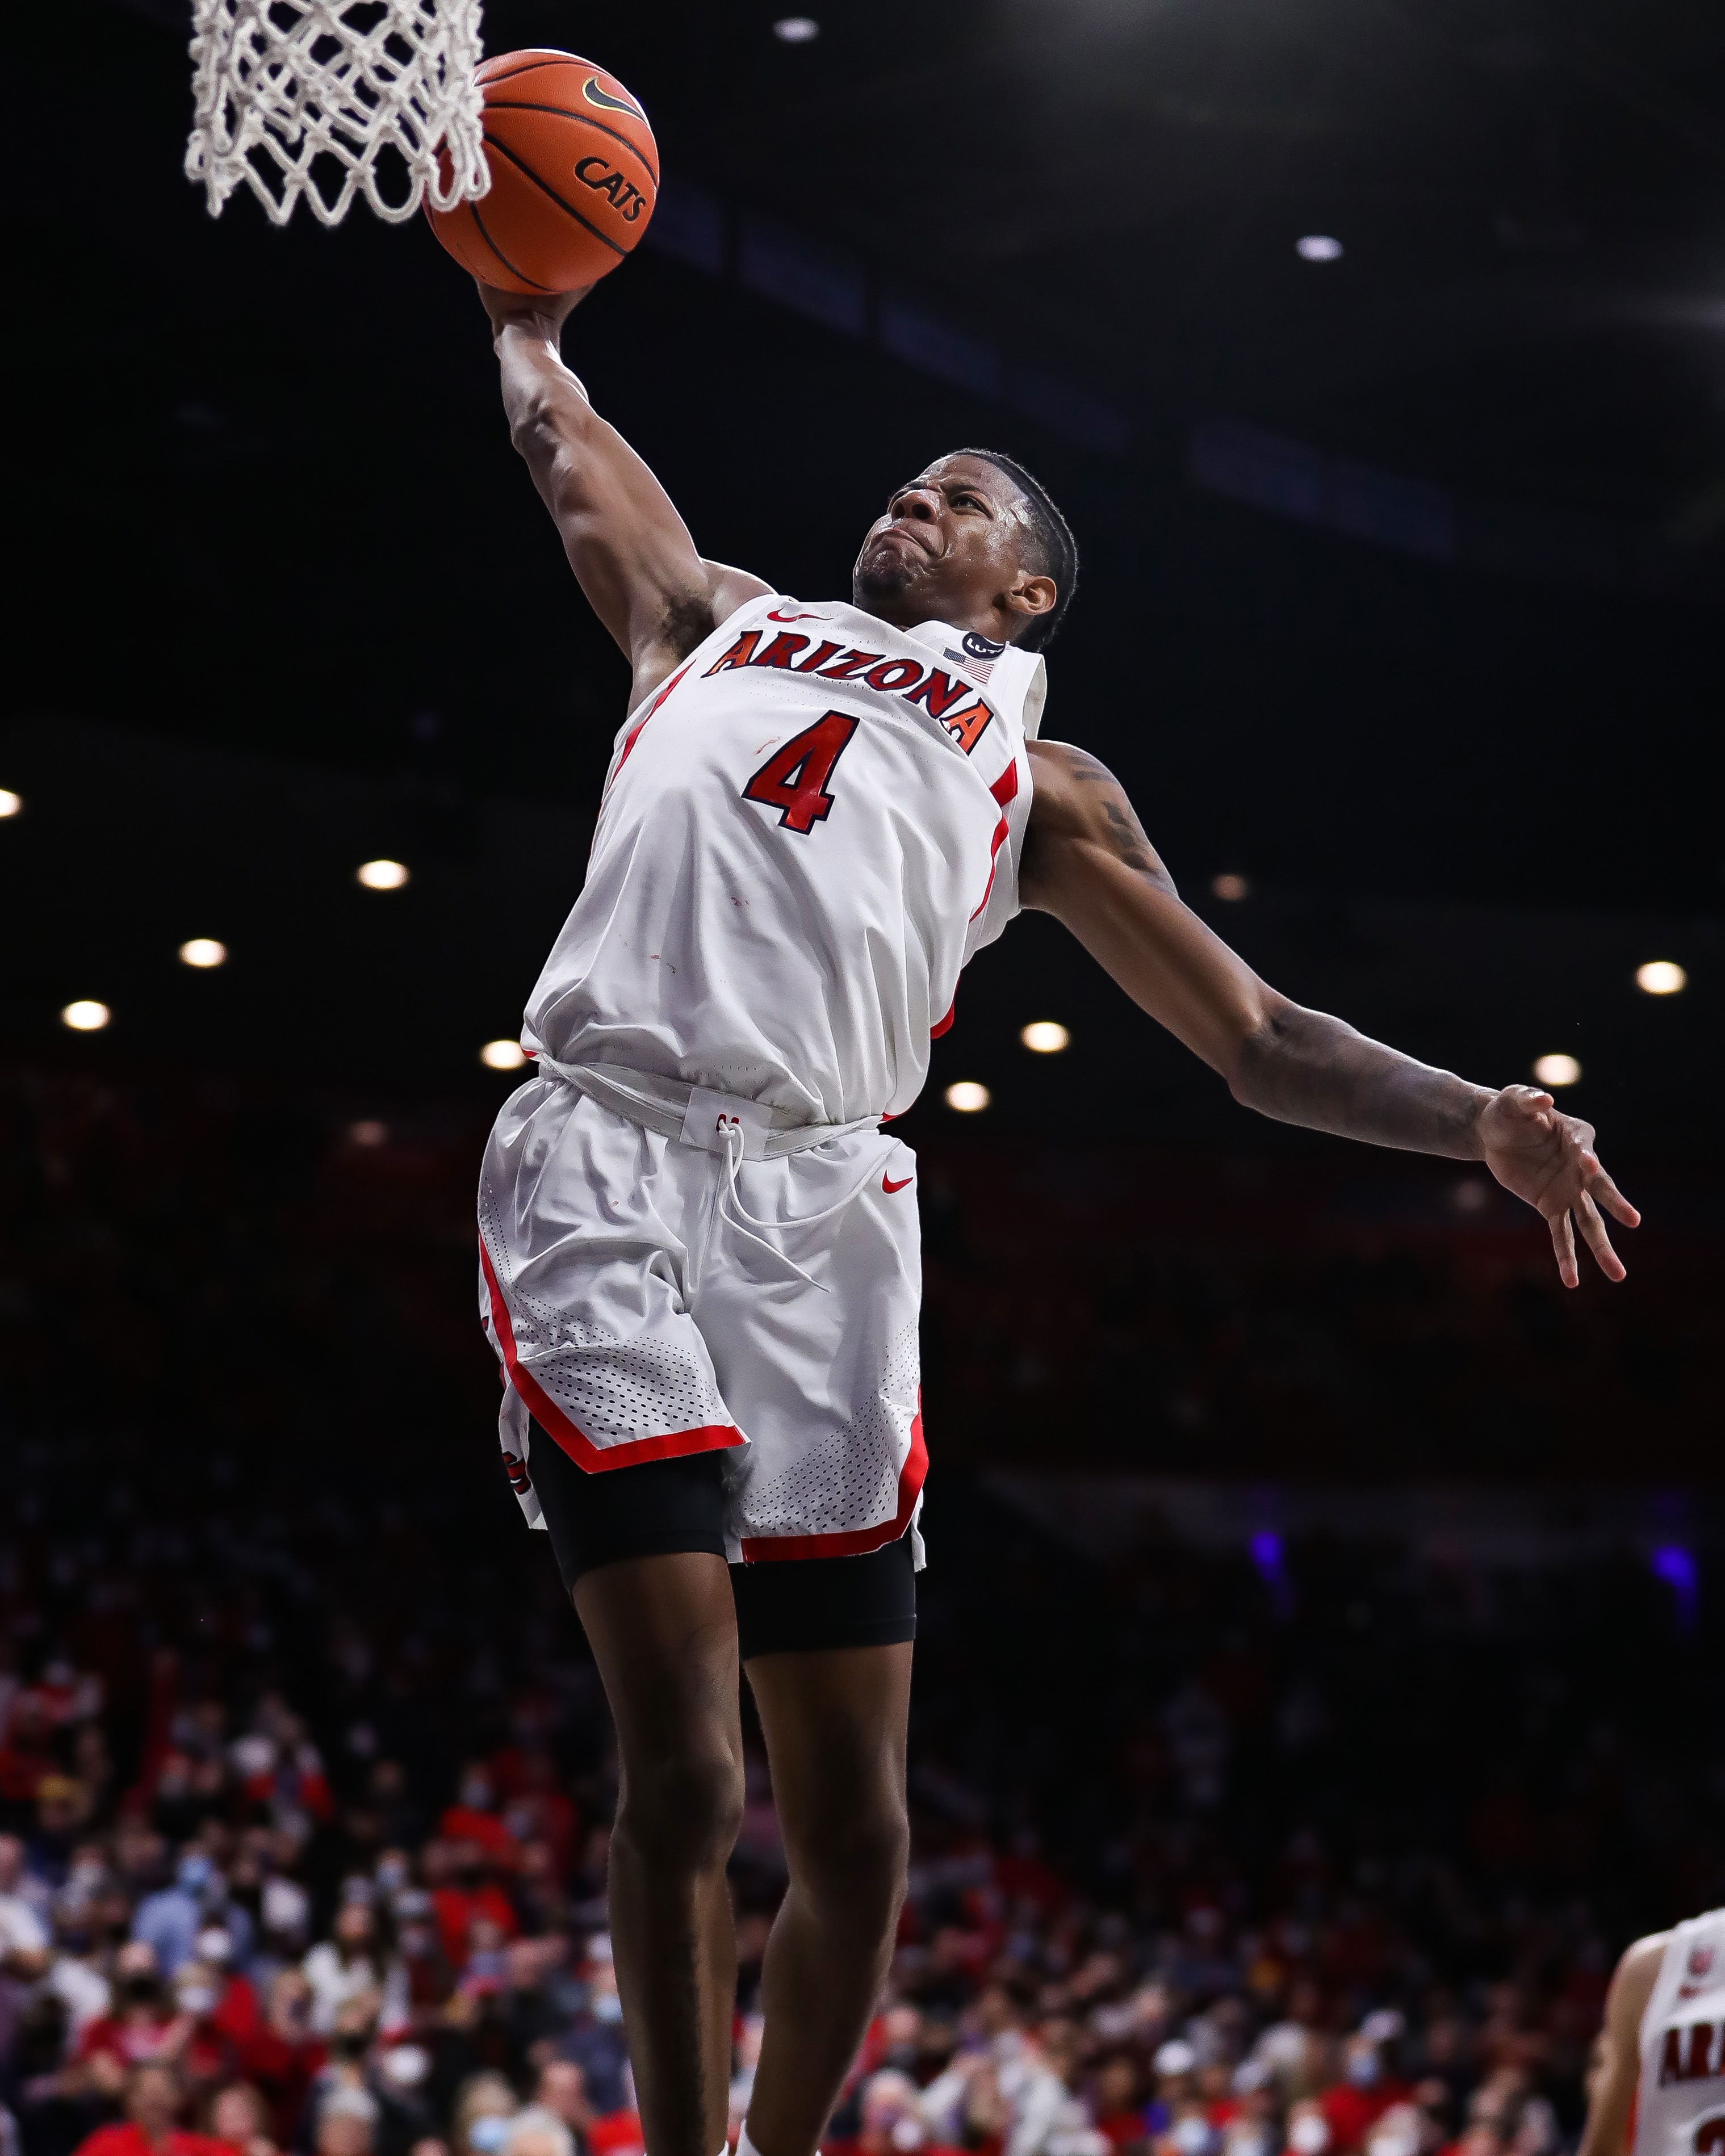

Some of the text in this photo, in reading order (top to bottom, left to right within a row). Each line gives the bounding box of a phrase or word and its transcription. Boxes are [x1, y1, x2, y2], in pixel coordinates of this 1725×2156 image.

[575, 157, 646, 221] CATS
[701, 630, 994, 756] ARIZONA
[742, 710, 860, 835] 4
